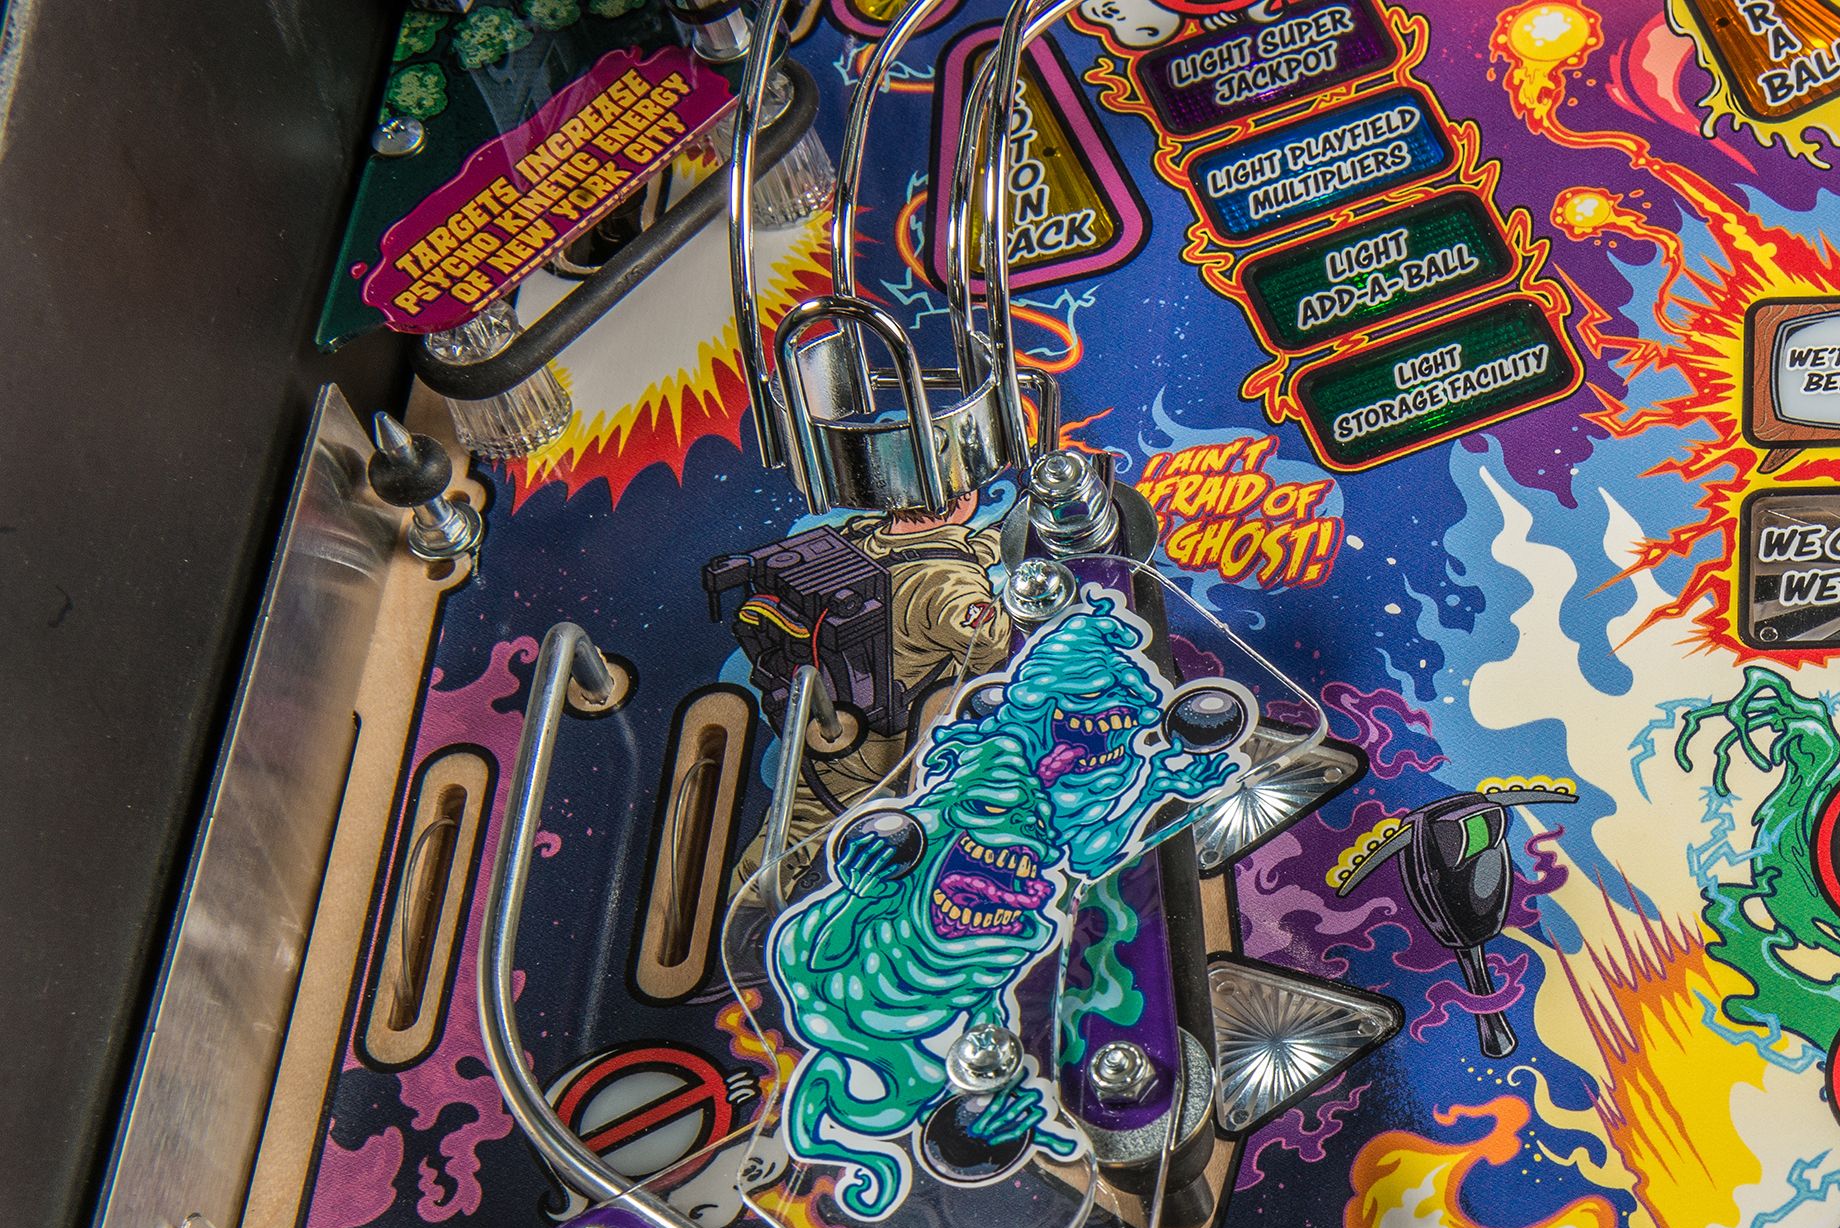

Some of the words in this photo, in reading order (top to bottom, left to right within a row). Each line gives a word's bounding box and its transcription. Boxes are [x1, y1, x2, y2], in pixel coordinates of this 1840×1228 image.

[1174, 40, 1250, 86] LIGHT
[1259, 9, 1352, 56] SUPER
[1216, 42, 1337, 103] JACKPOT
[395, 175, 522, 281] TARGETS
[515, 67, 655, 184] INCREASE
[1208, 153, 1281, 196] LIGHT
[1289, 107, 1420, 168] PLAYFIELD
[1249, 144, 1411, 219] MULTIPLIERS
[393, 231, 503, 316] PSYCHO
[493, 150, 601, 237] KINETIC
[595, 70, 692, 156] ENERGY
[449, 270, 495, 304] OF
[485, 219, 557, 276] NEW
[549, 159, 634, 221] YORK
[623, 112, 689, 165] CITY
[1327, 231, 1407, 280] LIGHT
[1335, 385, 1444, 441] STORAGE
[1447, 346, 1548, 399] FACILITY
[1396, 345, 1460, 388] LIGHT
[1142, 453, 1170, 480] I
[1163, 435, 1278, 475] AIN'T
[1263, 479, 1335, 519] OF
[1165, 517, 1344, 588] GHOST!
[1761, 525, 1826, 561] WE
